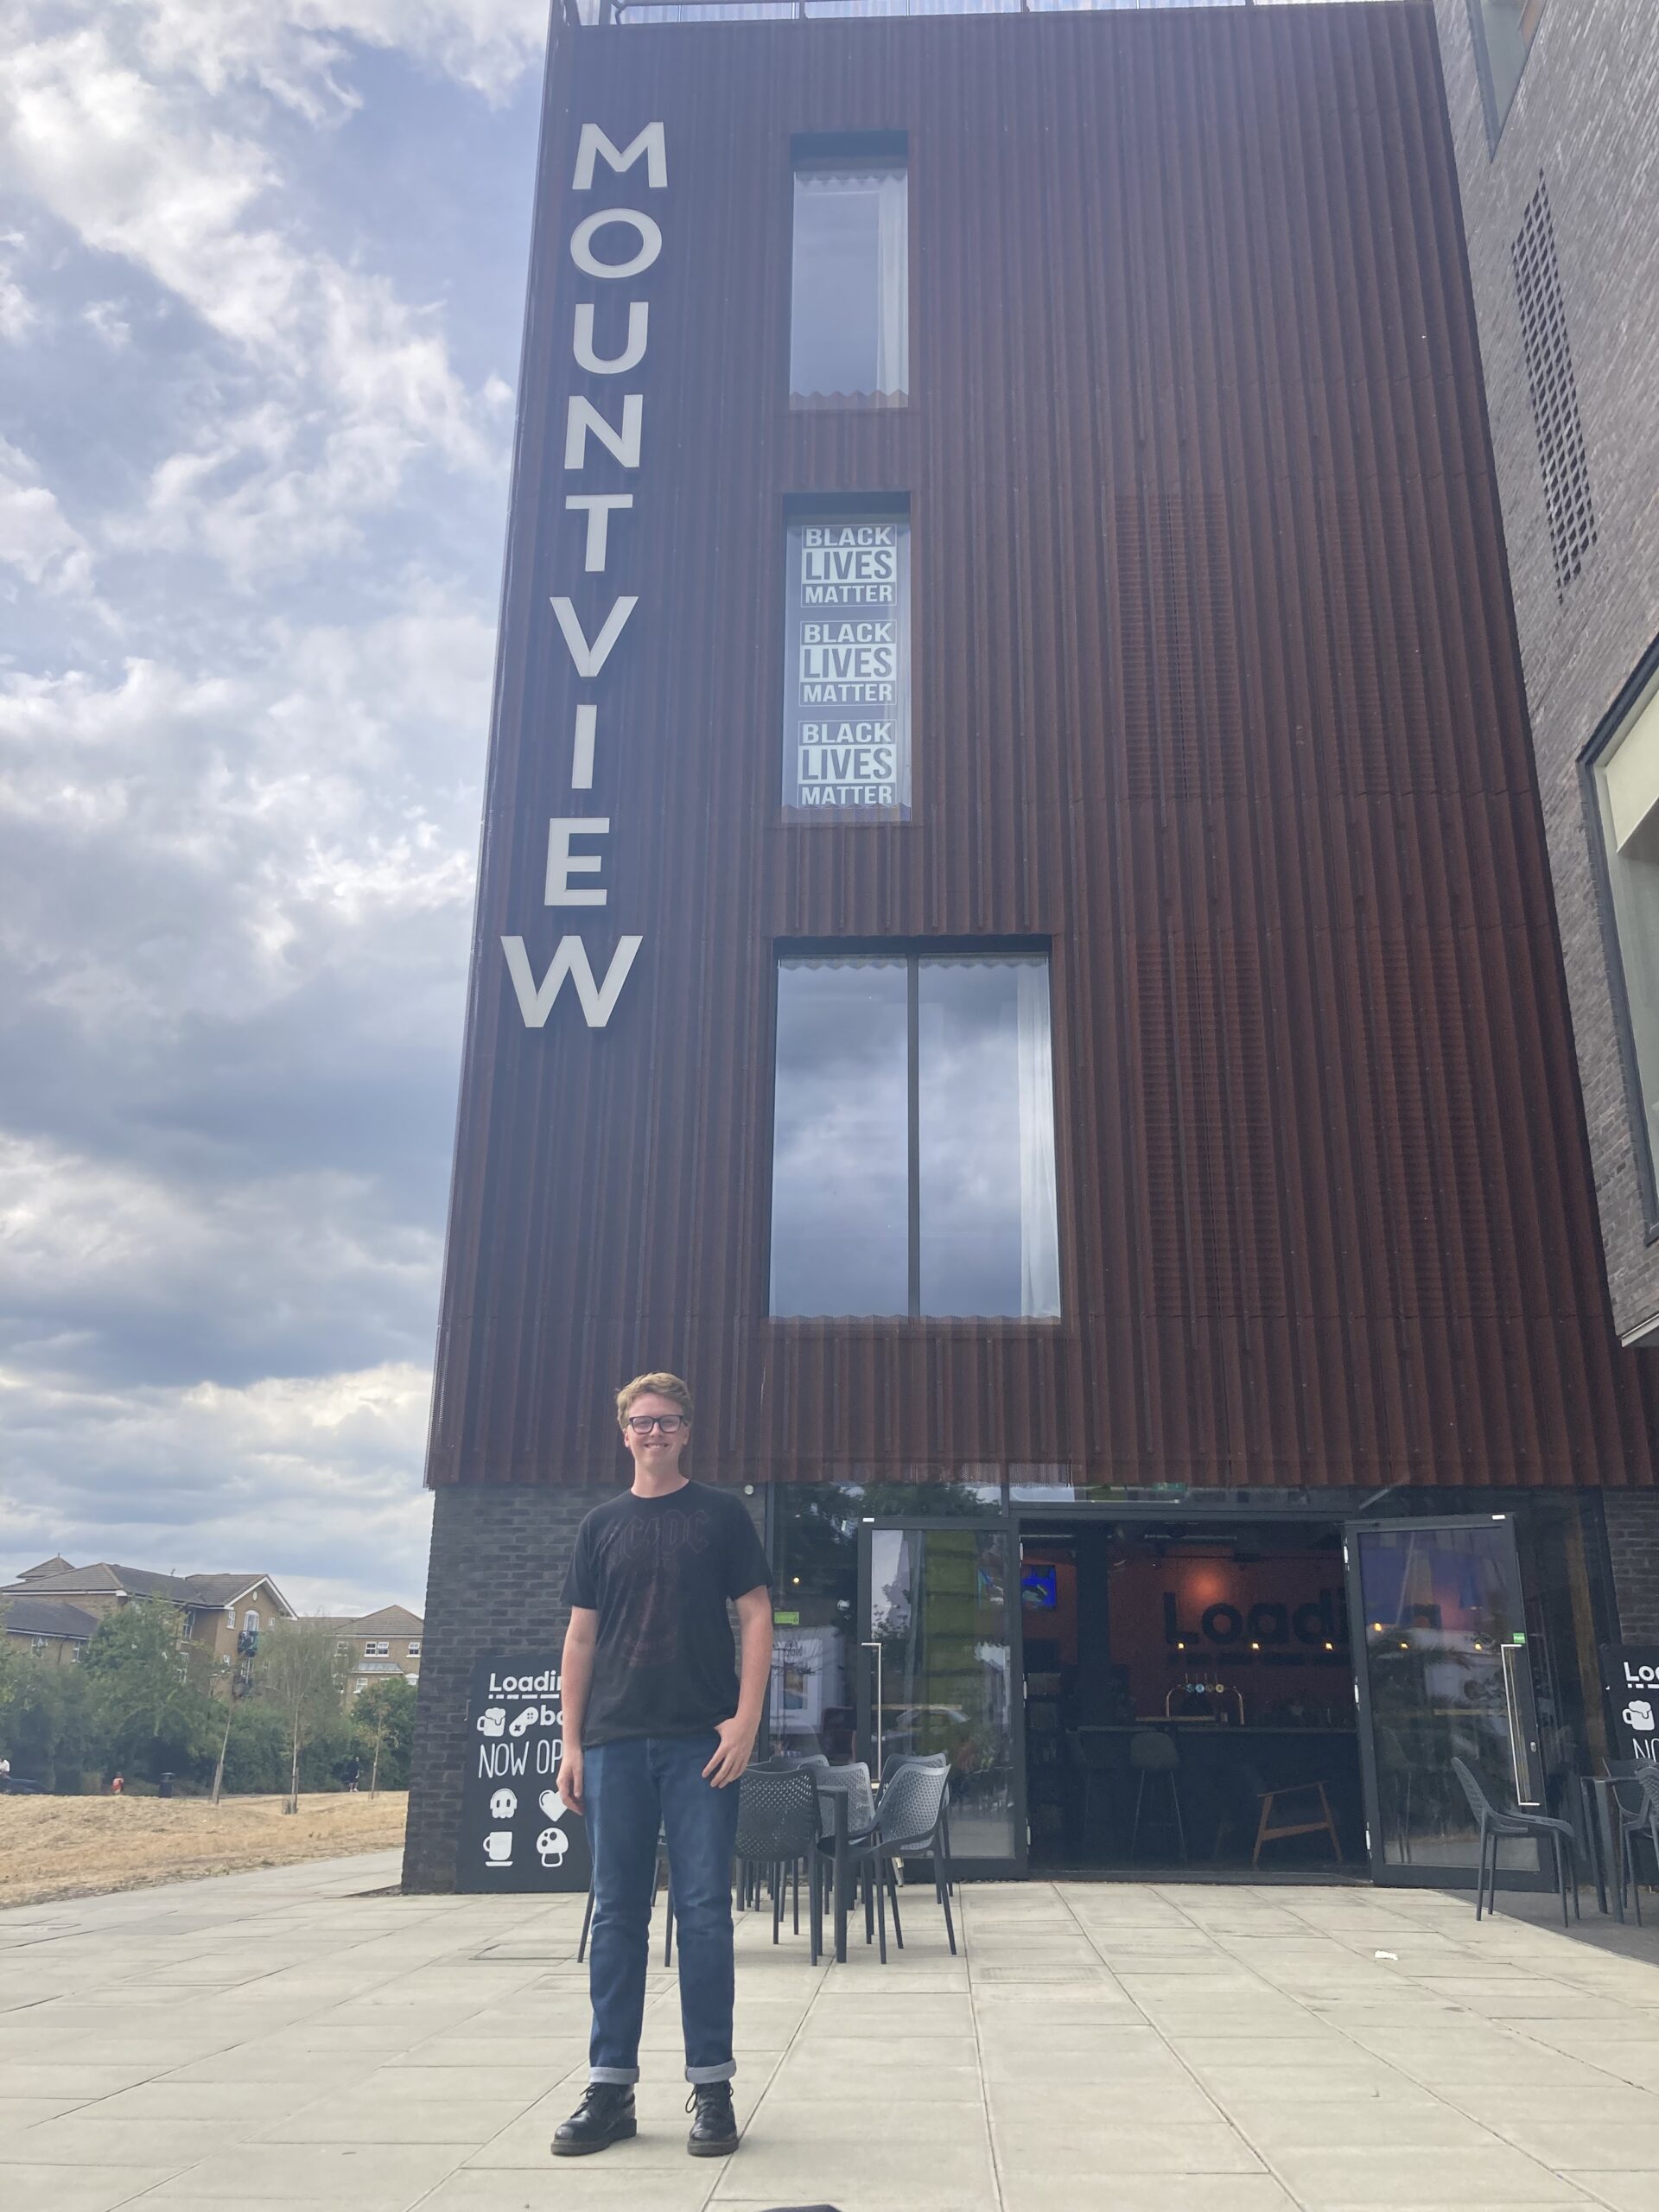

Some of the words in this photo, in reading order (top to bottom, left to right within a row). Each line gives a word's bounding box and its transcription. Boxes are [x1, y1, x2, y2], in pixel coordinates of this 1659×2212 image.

[805, 525, 893, 547] BLACK
[500, 121, 668, 1029] MOUNTVIEW
[805, 550, 893, 581] LIVES
[804, 584, 893, 603] MATTER
[804, 622, 893, 644] BLACK
[804, 646, 893, 678] LIVES
[803, 683, 893, 702] MATTER
[802, 722, 893, 744] BLACK
[802, 747, 893, 780] LIVES
[801, 783, 893, 805] MATTER
[1163, 1588, 1441, 1645] Loadi
[1624, 1662, 1659, 1681] Lo
[478, 1740, 530, 1778] NOW
